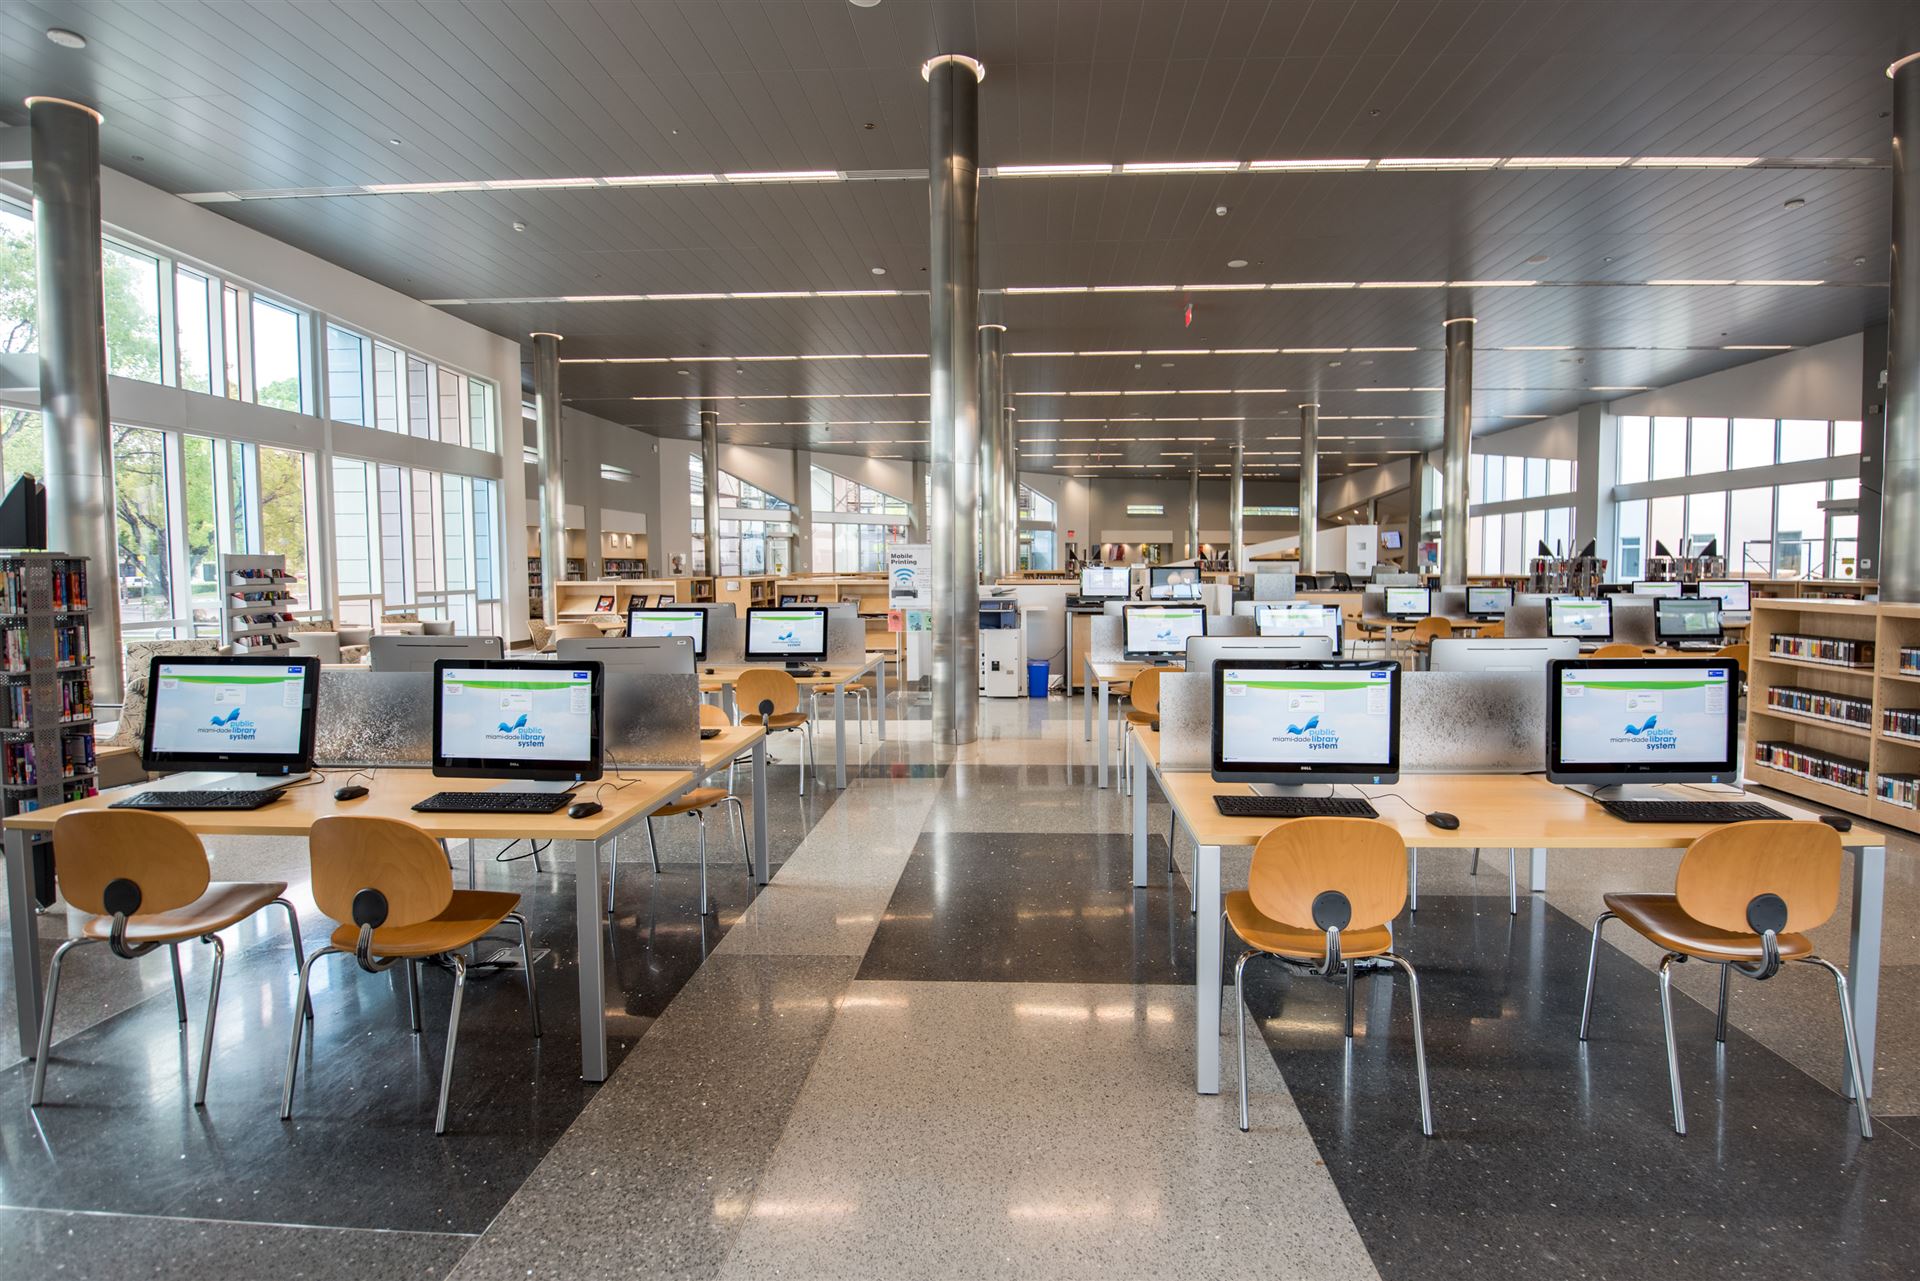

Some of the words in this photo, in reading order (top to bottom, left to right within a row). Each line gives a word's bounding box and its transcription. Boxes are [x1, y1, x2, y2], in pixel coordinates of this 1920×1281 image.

[1309, 728, 1336, 736] public
[1647, 728, 1673, 736] public
[520, 734, 545, 742] library
[1312, 735, 1339, 744] library
[1649, 735, 1677, 744] library
[518, 740, 544, 748] system
[1309, 742, 1338, 751] system
[1647, 742, 1676, 751] system
